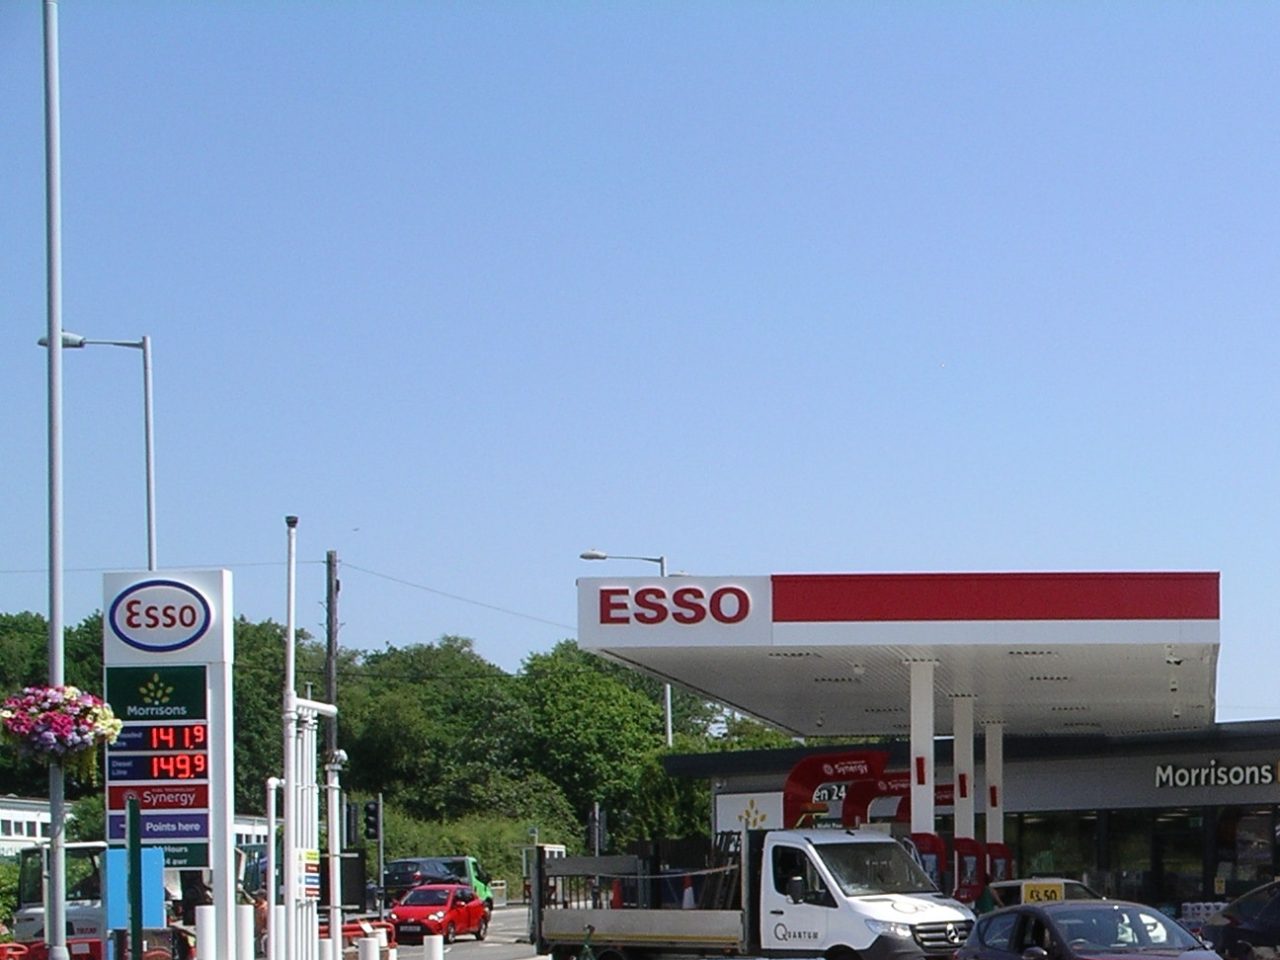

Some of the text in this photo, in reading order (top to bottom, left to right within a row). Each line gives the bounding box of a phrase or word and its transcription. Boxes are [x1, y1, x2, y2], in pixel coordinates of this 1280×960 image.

[599, 587, 751, 625] ESSO
[126, 705, 187, 716] Morrisons
[152, 753, 205, 778] 149.9
[834, 763, 868, 776] Synergy
[1155, 759, 1273, 788] Morrisons
[143, 791, 196, 806] Synergy
[832, 785, 847, 801] 24
[145, 822, 201, 832] Points here
[164, 845, 188, 853] Hours
